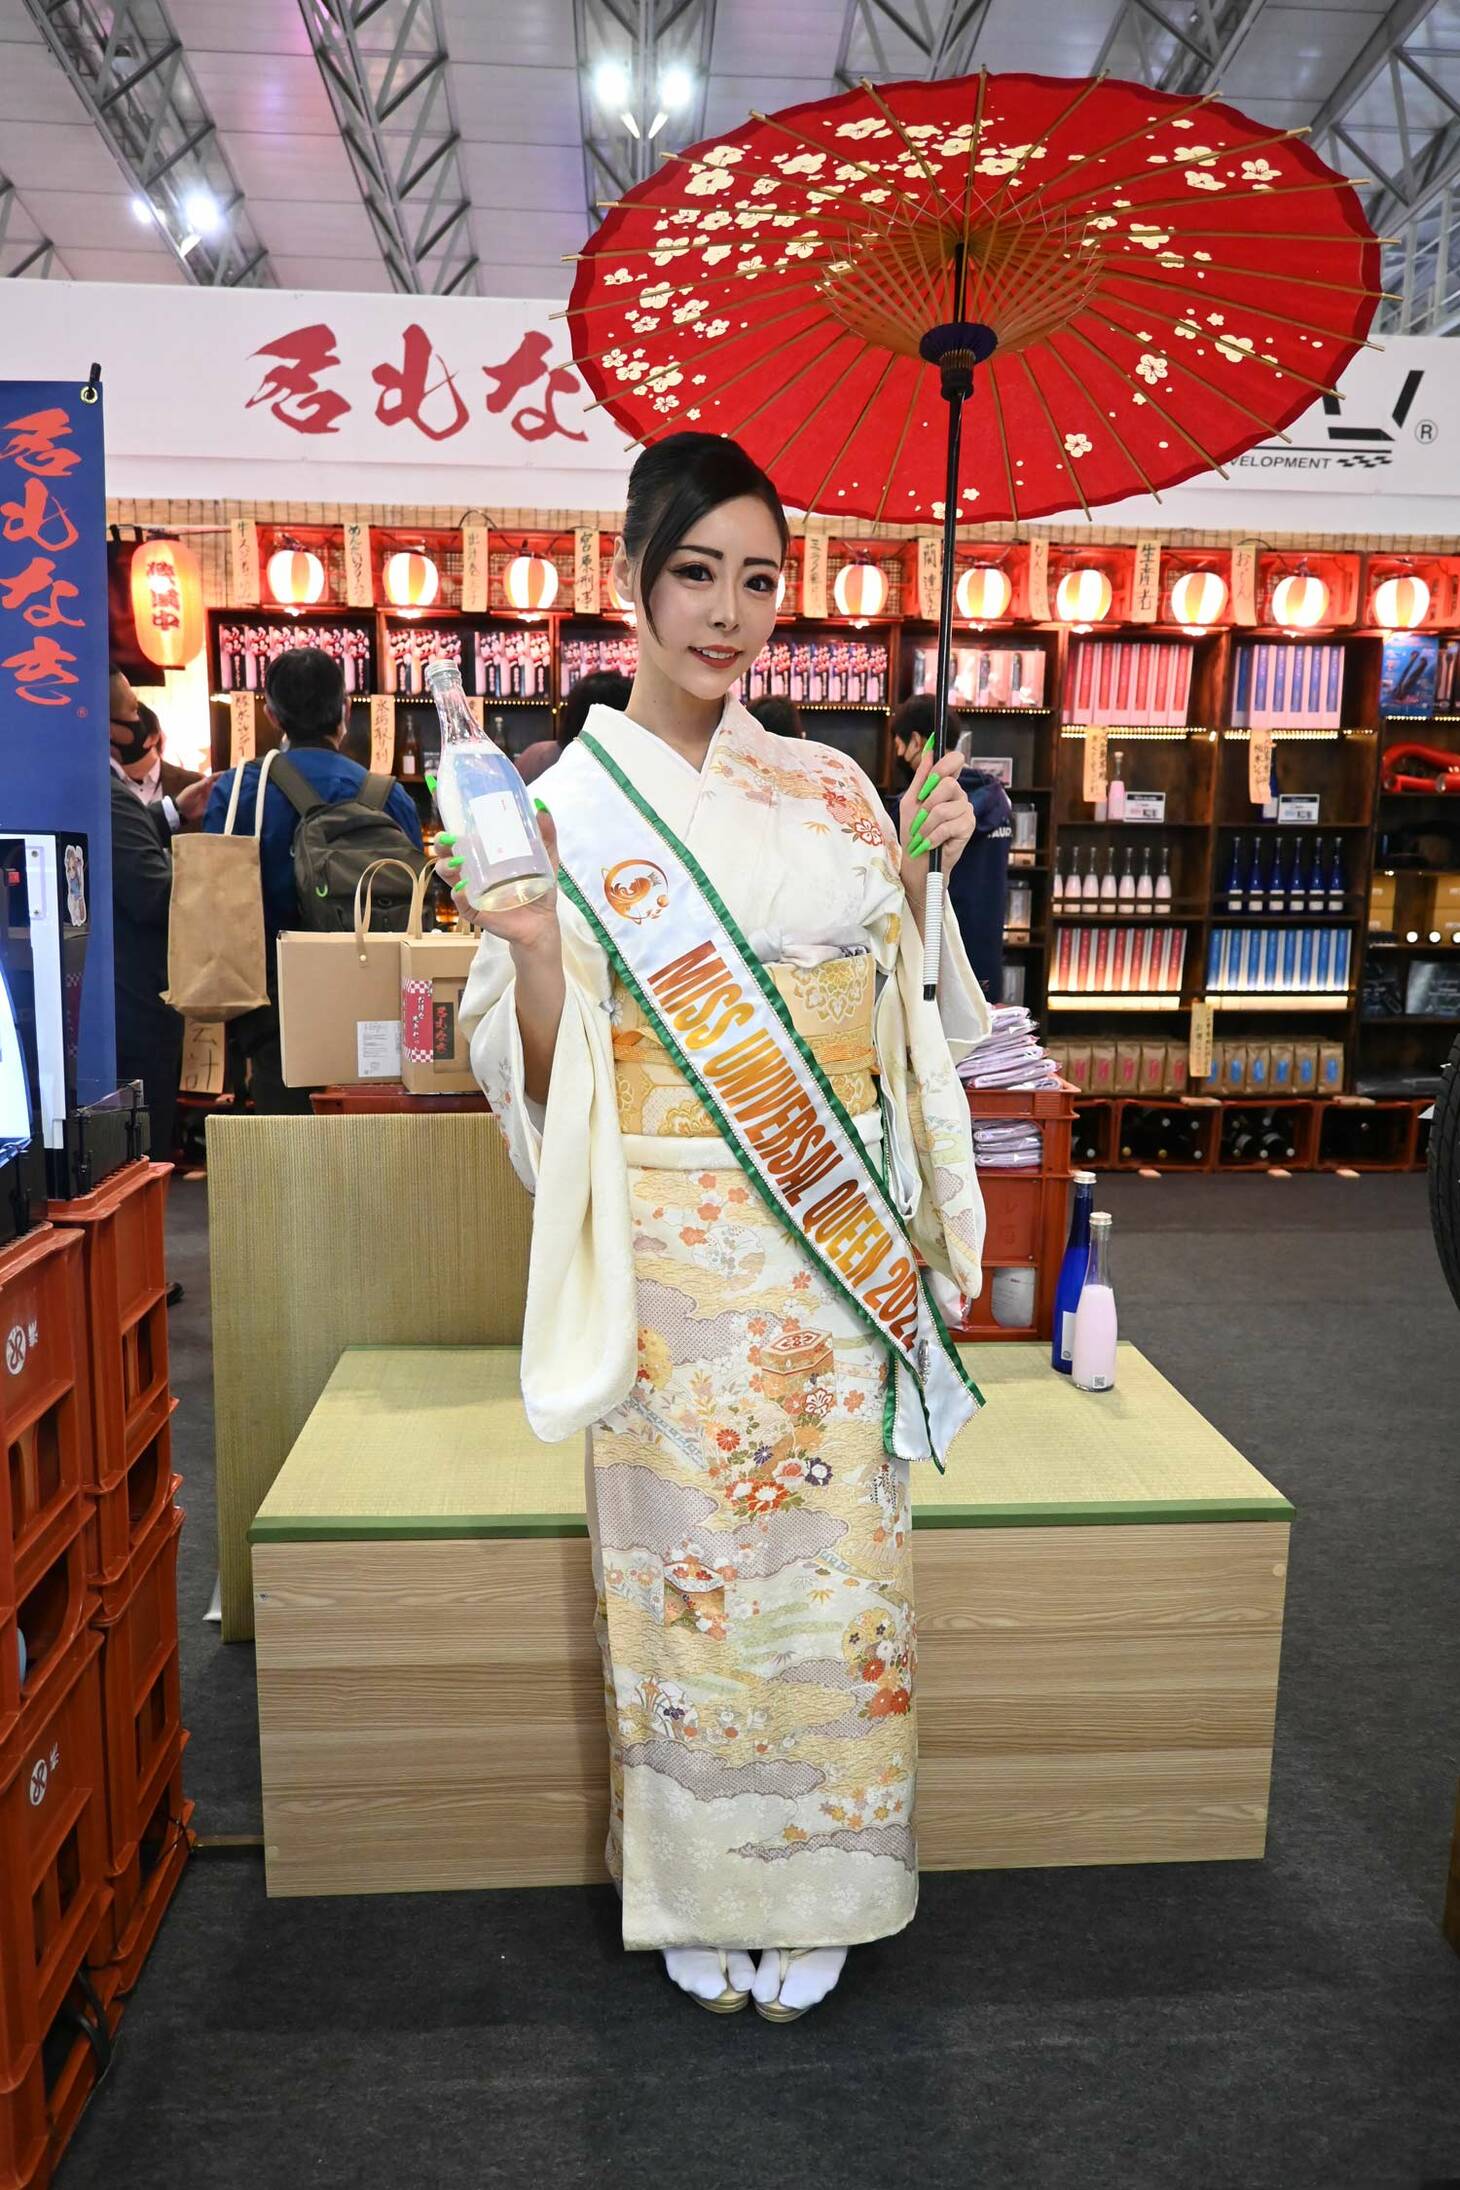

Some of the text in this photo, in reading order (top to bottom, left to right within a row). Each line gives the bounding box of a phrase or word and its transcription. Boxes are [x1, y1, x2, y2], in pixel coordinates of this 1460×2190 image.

[647, 940, 754, 1050] MISS
[703, 1027, 843, 1207] UNIVERSAL
[802, 1179, 893, 1288] QUEEN
